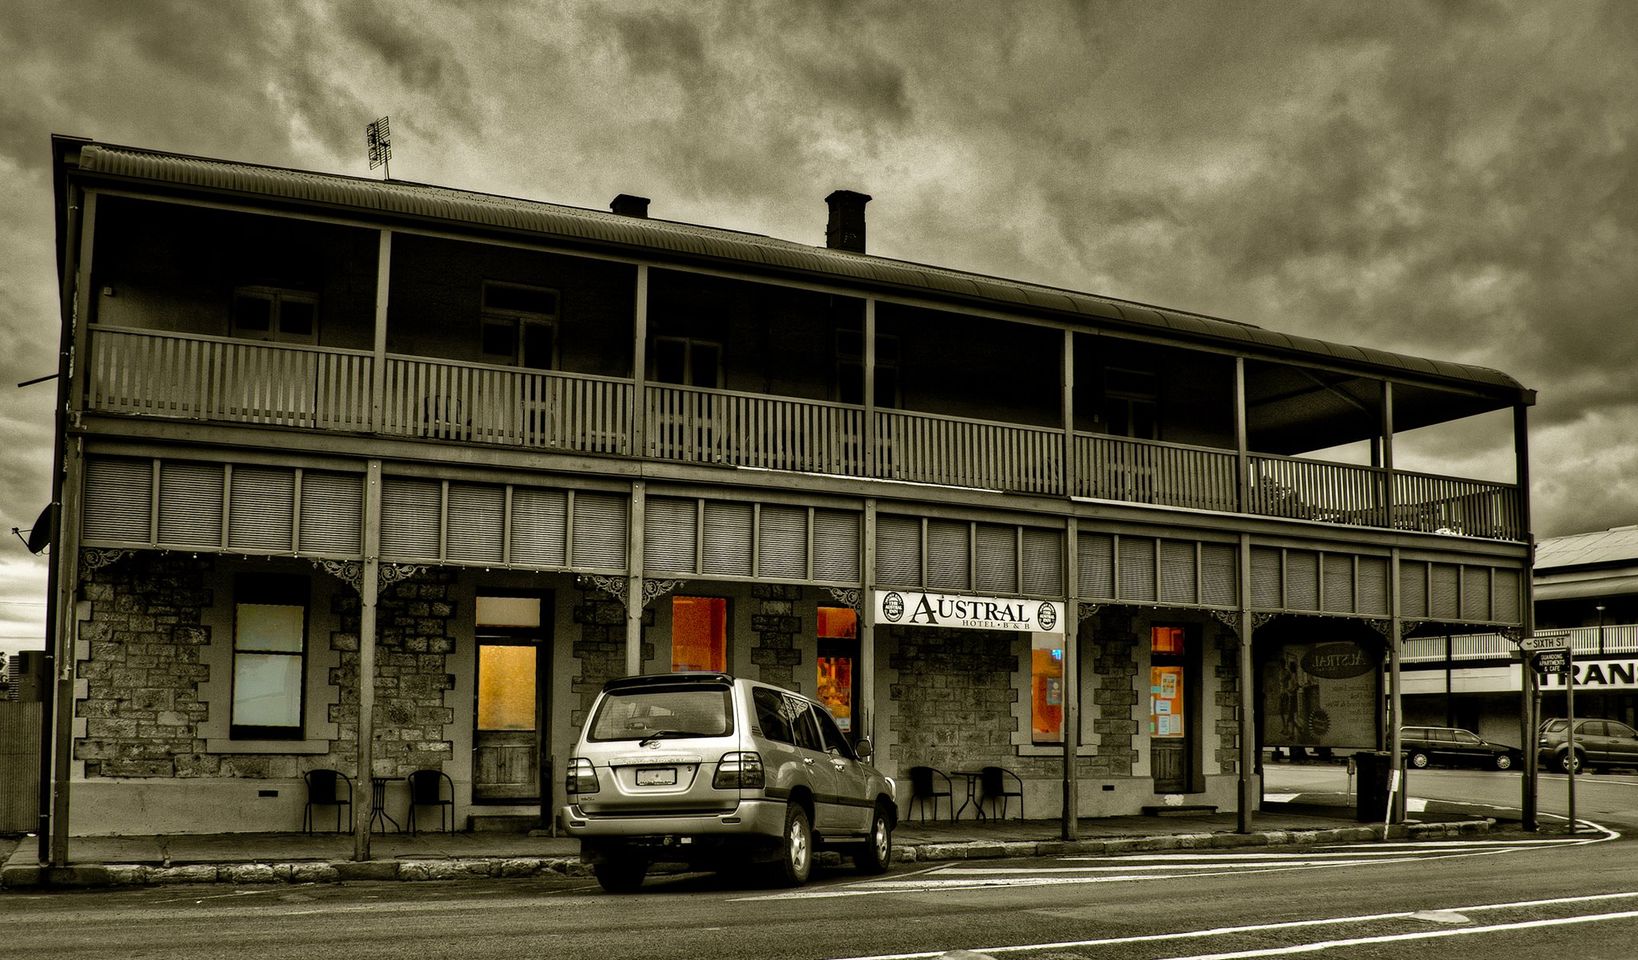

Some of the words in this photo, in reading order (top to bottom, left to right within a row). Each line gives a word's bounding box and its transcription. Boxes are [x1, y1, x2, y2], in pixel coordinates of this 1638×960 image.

[909, 593, 1030, 624] AUSTRAL
[962, 619, 999, 628] HOTEL
[1533, 638, 1554, 648] SIXTH
[1556, 637, 1565, 647] ST
